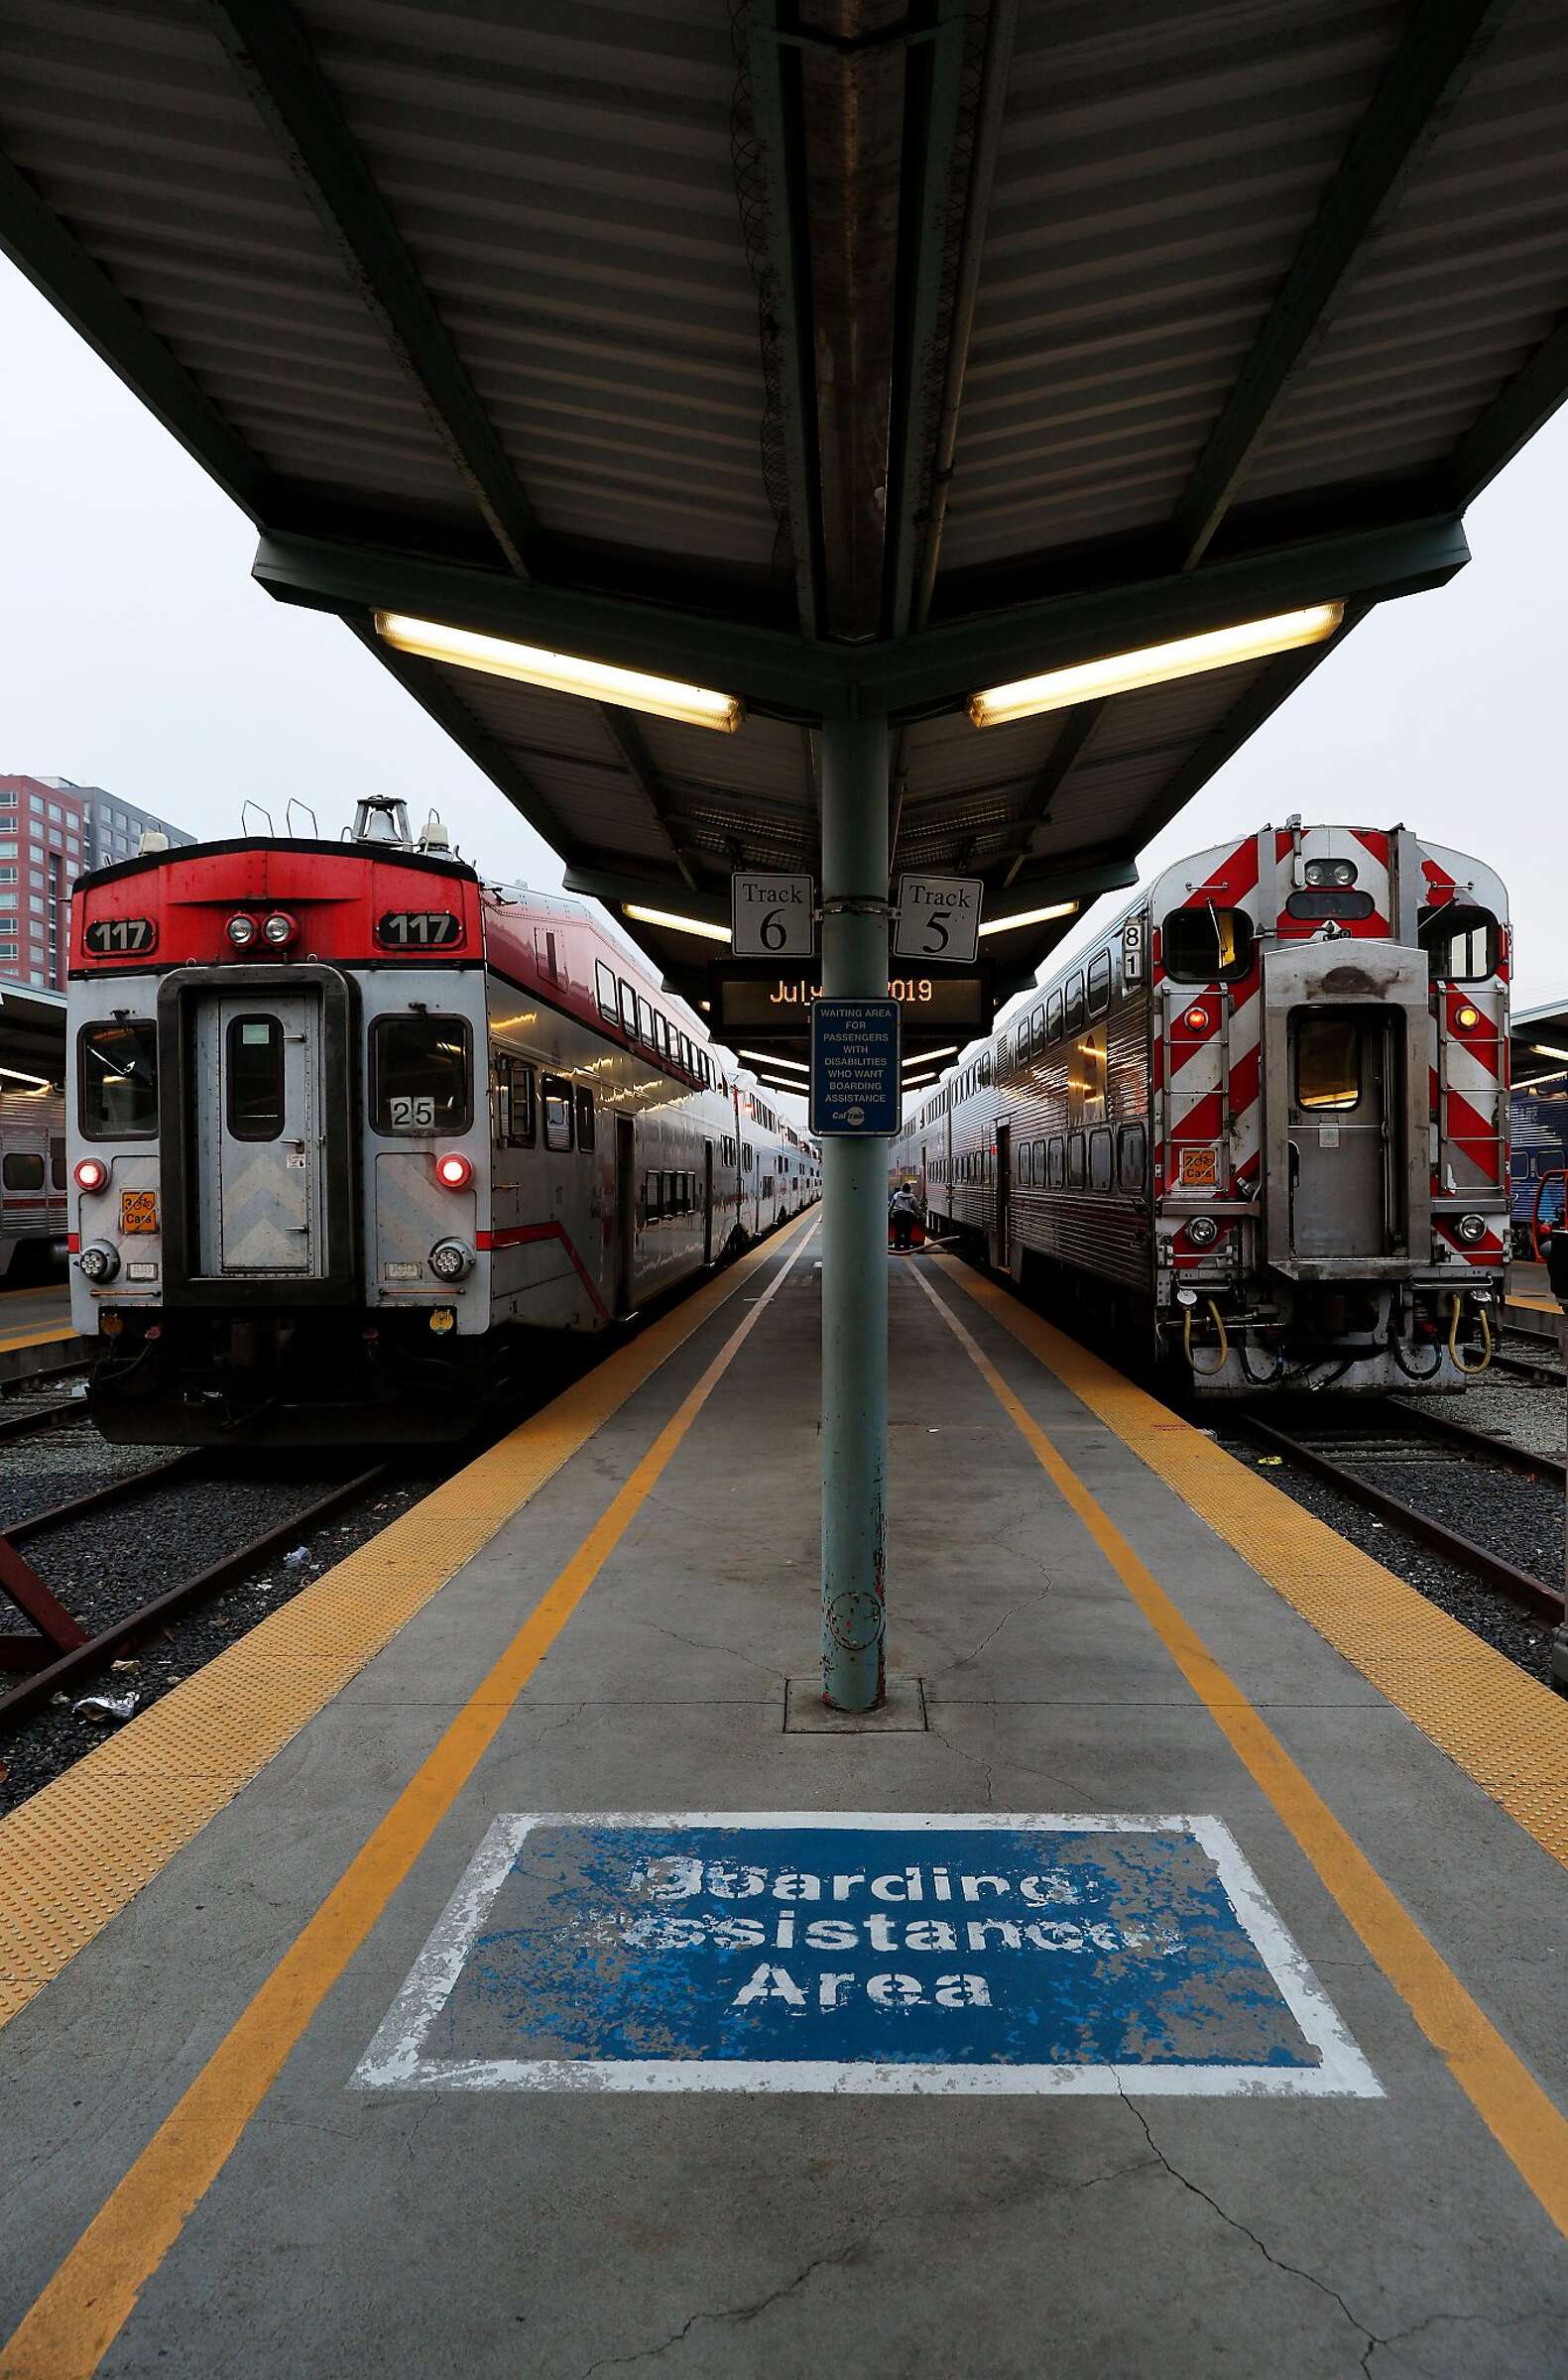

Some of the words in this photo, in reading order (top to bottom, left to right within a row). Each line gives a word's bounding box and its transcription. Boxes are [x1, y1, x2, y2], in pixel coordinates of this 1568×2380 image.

[743, 884, 803, 903] Track
[909, 885, 971, 908] Track
[95, 920, 146, 950] 117
[388, 915, 450, 943] 117
[759, 908, 787, 950] 6
[922, 911, 952, 953] 5
[887, 979, 932, 1002] 019
[820, 1009, 862, 1017] WAITING
[865, 1009, 892, 1017] AREA
[845, 1020, 866, 1029] FOR
[823, 1033, 890, 1042] PASSENGERS
[843, 1045, 868, 1054] WITH
[824, 1057, 888, 1066] DISABILITIES
[829, 1082, 882, 1091] BOARDING
[824, 1094, 887, 1103] ASSISTANCE
[393, 1102, 432, 1126] 25
[731, 1962, 994, 2010] Area
